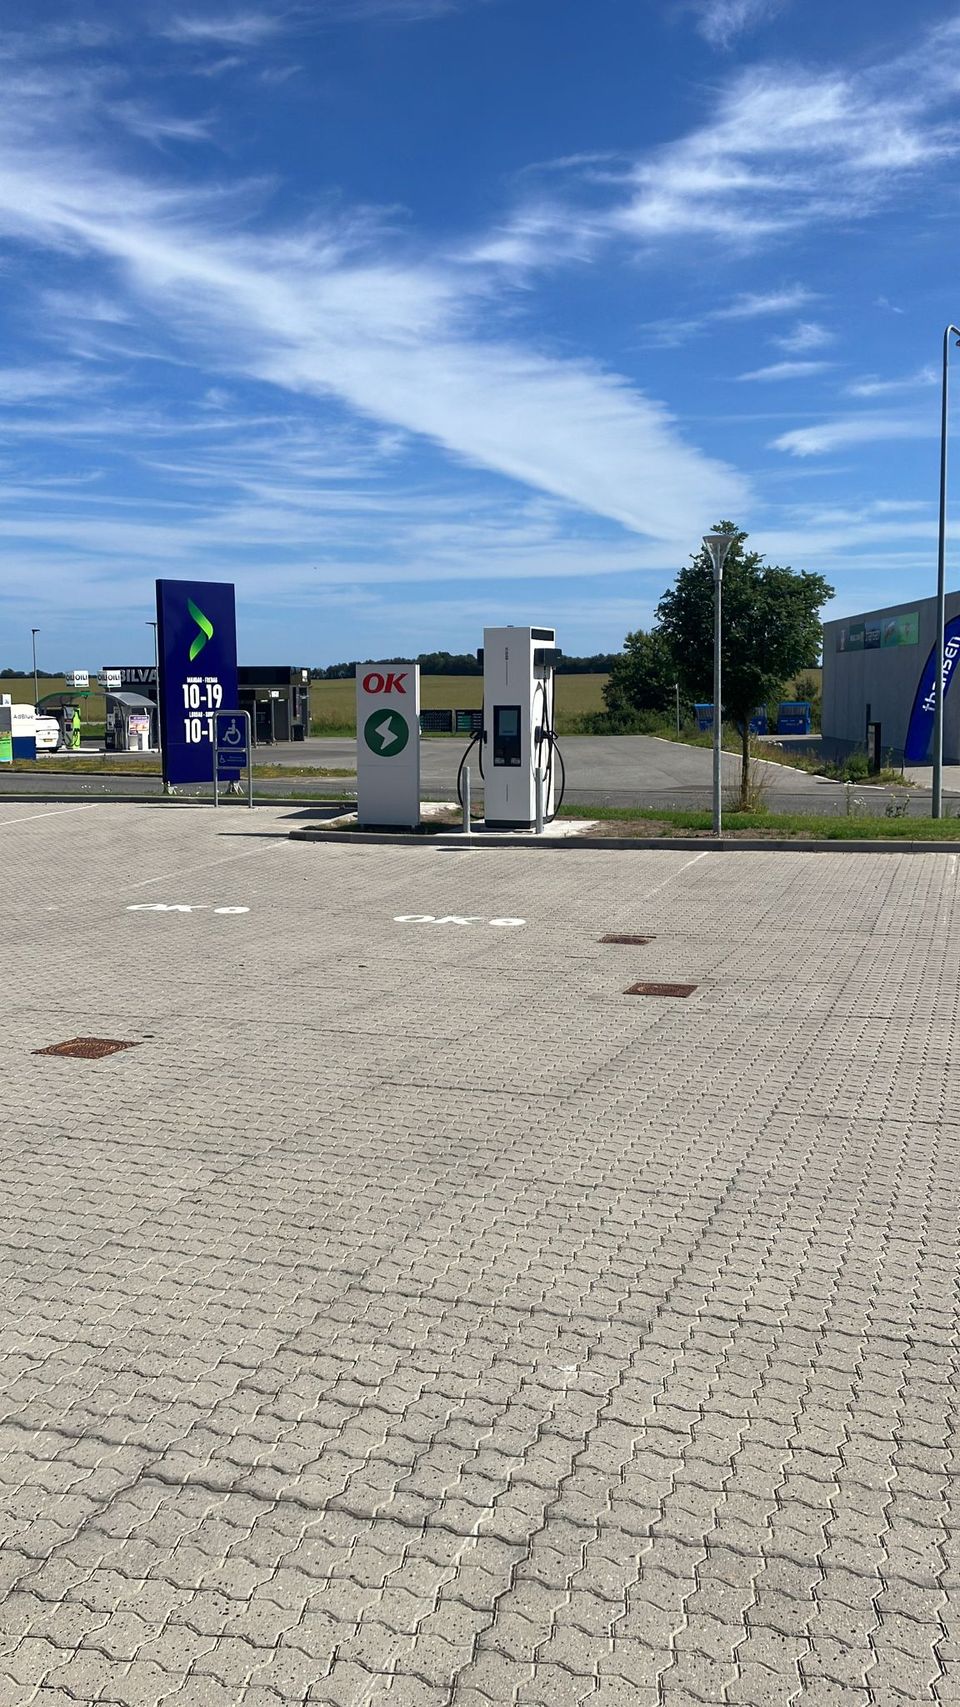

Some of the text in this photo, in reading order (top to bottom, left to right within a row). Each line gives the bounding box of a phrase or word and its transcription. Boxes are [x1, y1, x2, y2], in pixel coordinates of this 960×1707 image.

[120, 669, 157, 683] BILVA
[362, 672, 409, 694] OK
[922, 636, 960, 712] thnsen
[182, 684, 223, 709] 10-19
[184, 718, 214, 743] 10-1
[393, 914, 483, 924] OK
